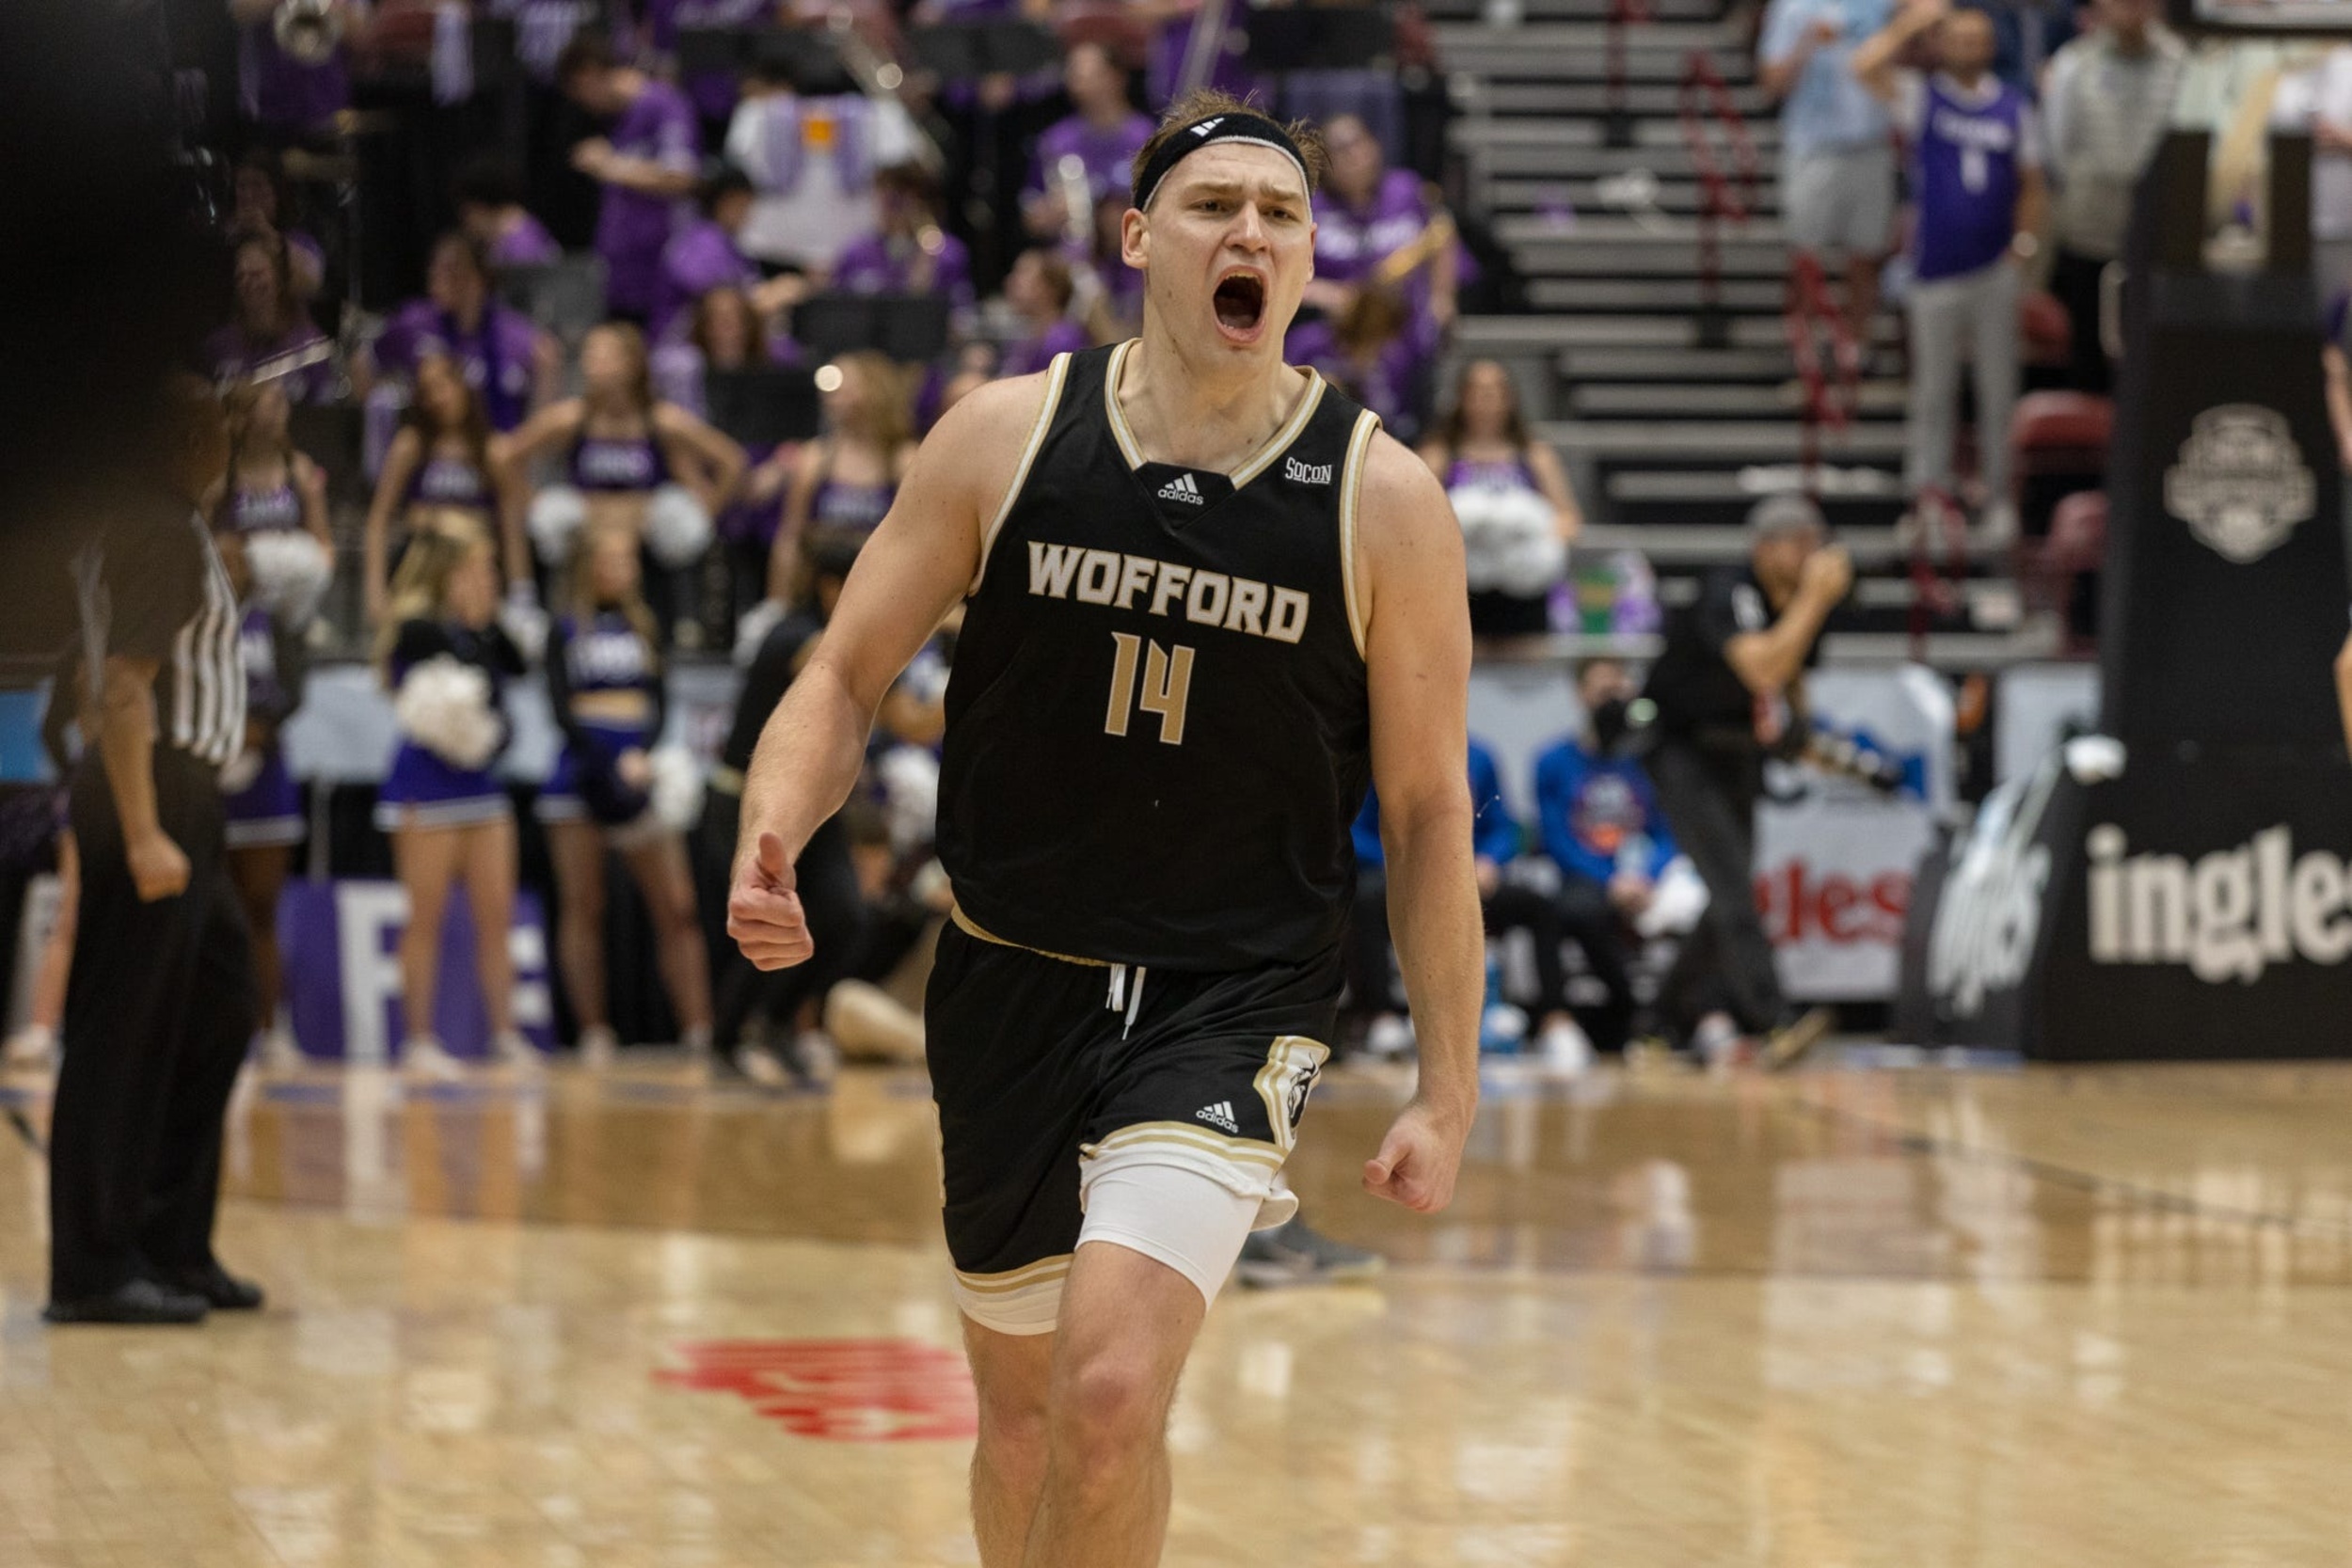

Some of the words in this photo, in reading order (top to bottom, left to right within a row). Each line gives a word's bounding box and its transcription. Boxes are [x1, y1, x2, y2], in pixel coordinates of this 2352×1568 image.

[1157, 487, 1204, 505] adidas
[1027, 540, 1311, 644] WOFFORD
[1104, 631, 1196, 745] 14
[2085, 821, 2352, 986] ingle
[1196, 1109, 1239, 1133] adidas
